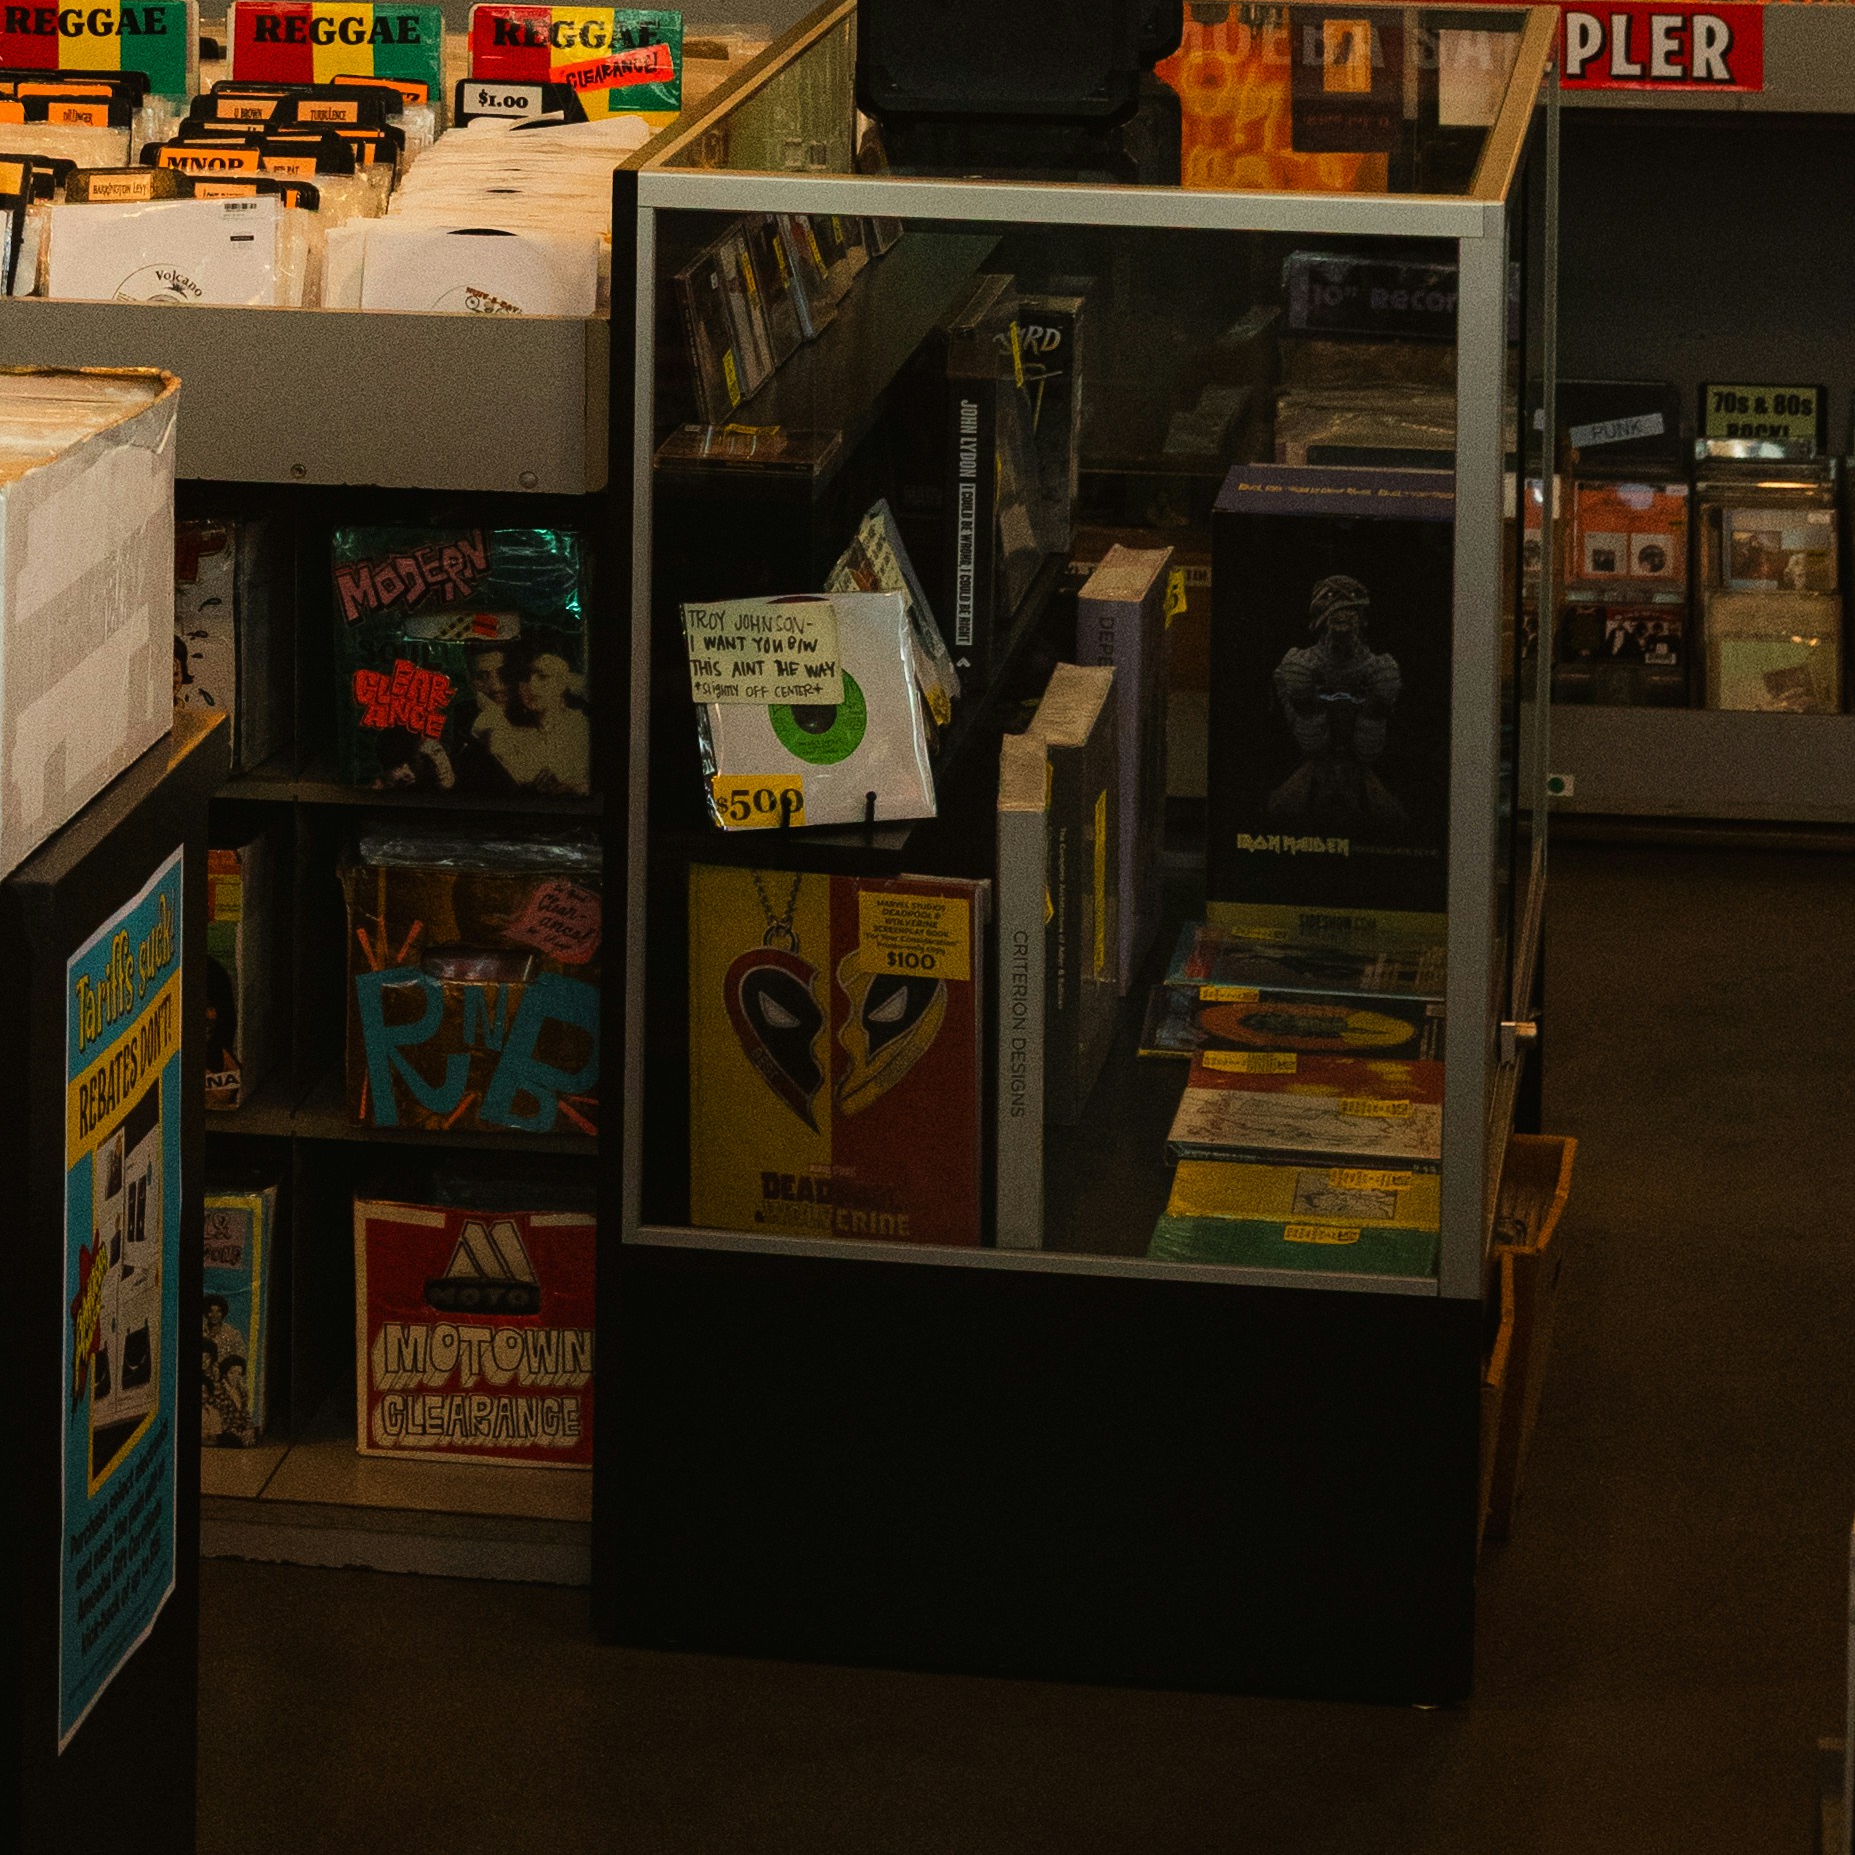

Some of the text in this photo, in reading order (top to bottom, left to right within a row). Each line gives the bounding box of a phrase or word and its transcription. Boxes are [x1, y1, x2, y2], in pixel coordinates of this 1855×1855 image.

[4, 6, 168, 38] REGGAE
[253, 14, 422, 45] REGGAE
[492, 17, 662, 49] REGGAE
[565, 48, 659, 88] CLEARANCE!
[310, 107, 348, 121] TURBULENCE
[478, 89, 529, 109] $1.00
[155, 270, 203, 298] Volcano
[959, 399, 978, 478] JOHN LYDON
[1592, 420, 1642, 442] PUNK
[335, 530, 494, 625] MODERN
[687, 609, 726, 631] TROY
[703, 635, 747, 652] WANT
[752, 637, 783, 654] YOU
[690, 657, 836, 679] THIS AINT THE WAY
[716, 788, 804, 822] $500
[1237, 833, 1350, 857] IRON MAIDEN
[75, 891, 175, 1054] Tariffs suck!
[887, 951, 936, 970] $100
[1009, 929, 1028, 1118] CRITERION DESIGNS
[78, 991, 172, 1139] REBATES DON'T!
[382, 1322, 594, 1379] MOTOWN
[382, 1392, 582, 1441] CLEARANCE
